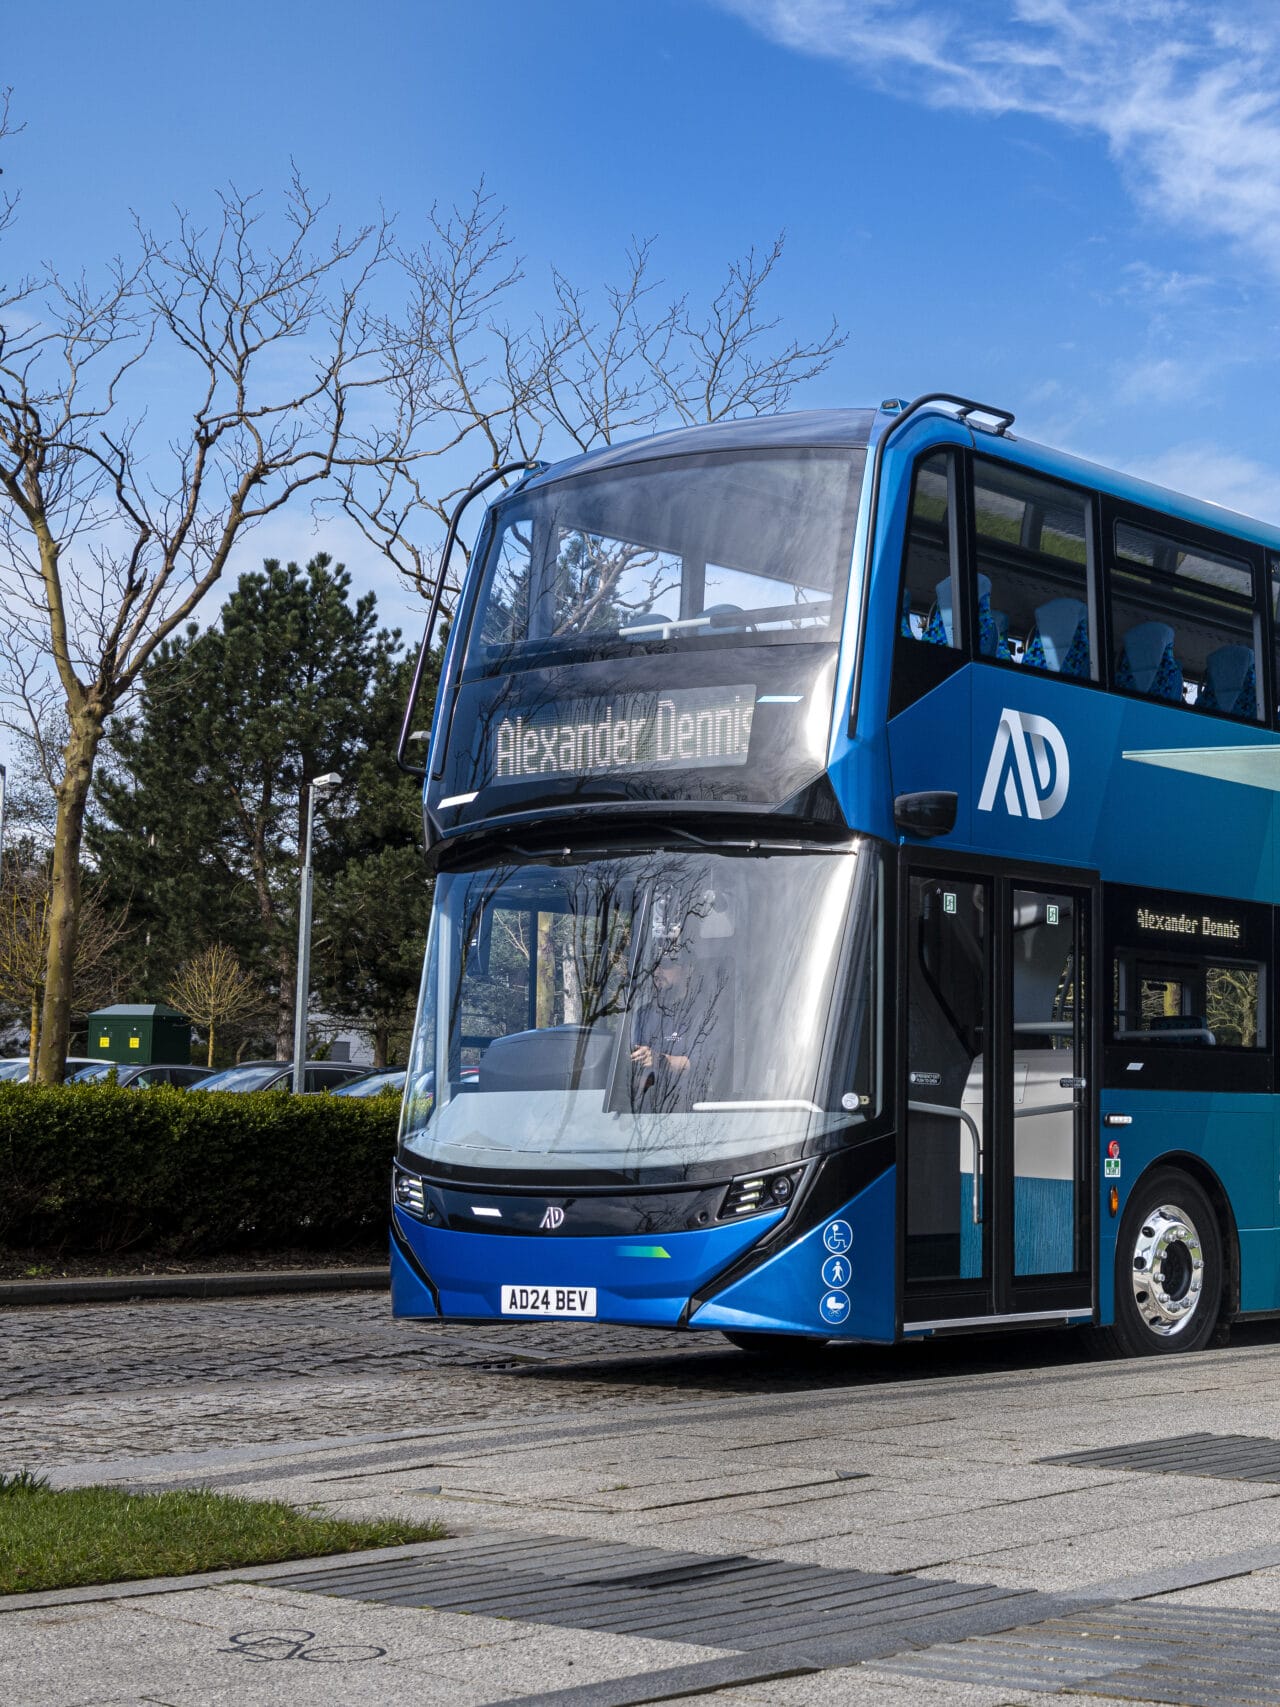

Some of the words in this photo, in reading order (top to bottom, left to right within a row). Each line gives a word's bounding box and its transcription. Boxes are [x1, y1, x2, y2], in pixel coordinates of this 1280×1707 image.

[497, 706, 646, 776] Alexander
[977, 707, 1070, 820] AD
[1137, 909, 1198, 933] Alexander
[1202, 917, 1240, 938] Dennis
[509, 1289, 551, 1310] AD24
[555, 1290, 588, 1311] BEV
